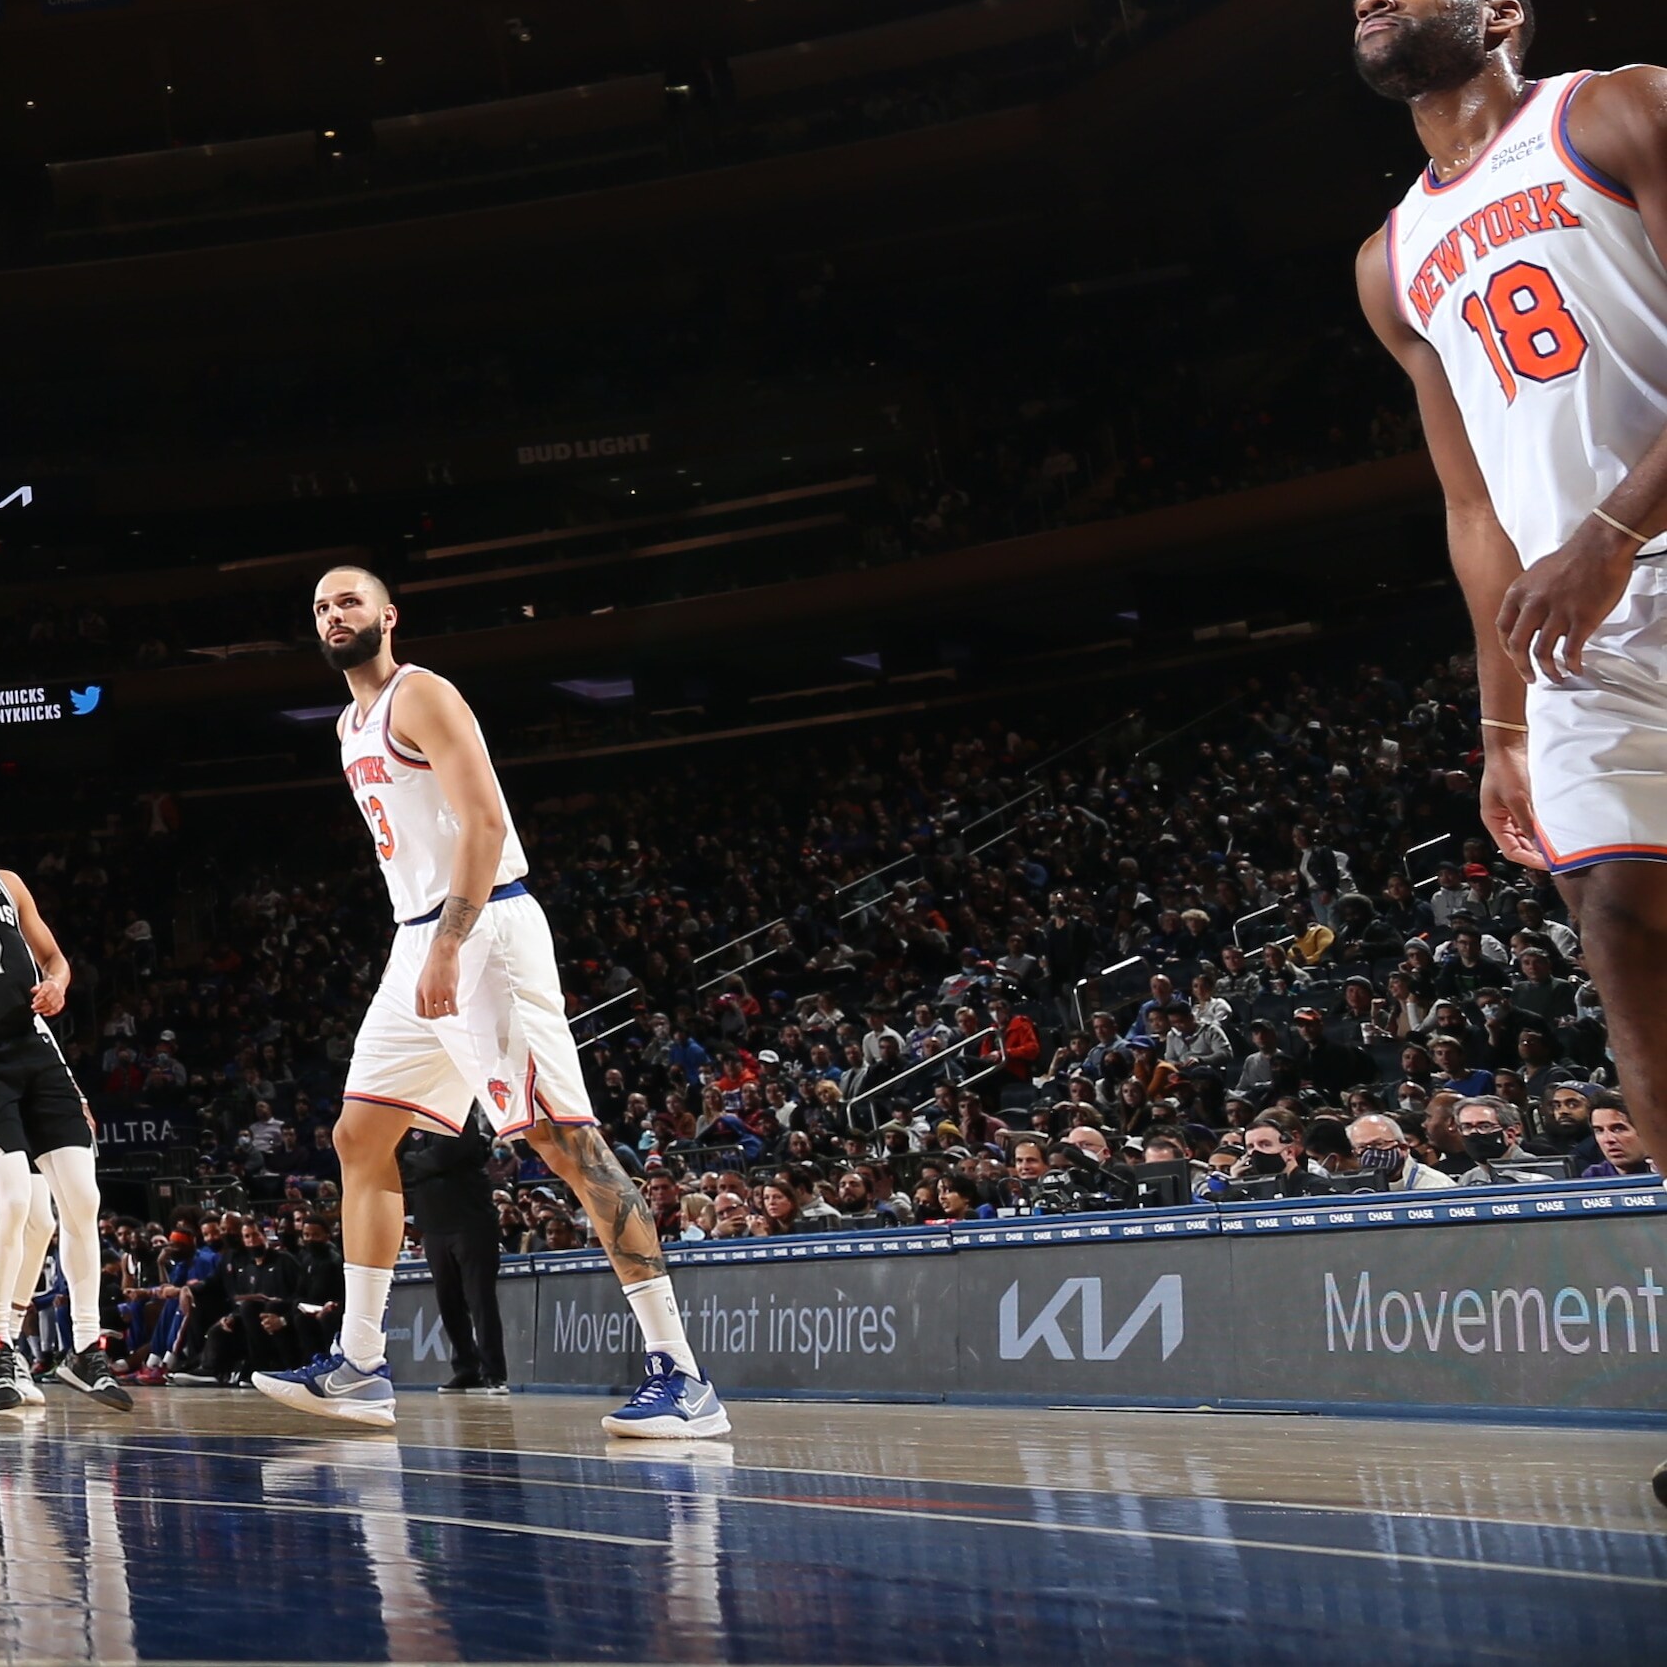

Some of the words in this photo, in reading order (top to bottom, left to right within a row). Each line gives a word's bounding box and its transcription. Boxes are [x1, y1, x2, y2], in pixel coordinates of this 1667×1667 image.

[1491, 133, 1544, 163] SQUARE
[1491, 147, 1534, 173] SPACE
[1407, 226, 1468, 332] NEW
[1462, 180, 1586, 262] YORK
[1461, 259, 1589, 408] 18
[517, 441, 570, 466] BUD
[574, 432, 650, 459] LIGHT
[1536, 1201, 1566, 1213] CHASE
[1582, 1197, 1613, 1209] CHASE
[1623, 1195, 1656, 1207] CHASE
[1408, 1209, 1434, 1220] CHASE
[1449, 1206, 1476, 1218] CHASE
[1492, 1204, 1520, 1215] CHASE
[1292, 1215, 1316, 1226] CHASE
[1329, 1213, 1354, 1223] CHASE
[1368, 1211, 1394, 1222] CHASE
[1154, 1223, 1175, 1233] CHASE
[1186, 1221, 1208, 1231] CHASE
[1222, 1220, 1243, 1231] CHASE
[1256, 1218, 1279, 1229] CHASE
[1324, 1267, 1664, 1354] Movement
[701, 1296, 759, 1353] that
[769, 1295, 896, 1370] inspires
